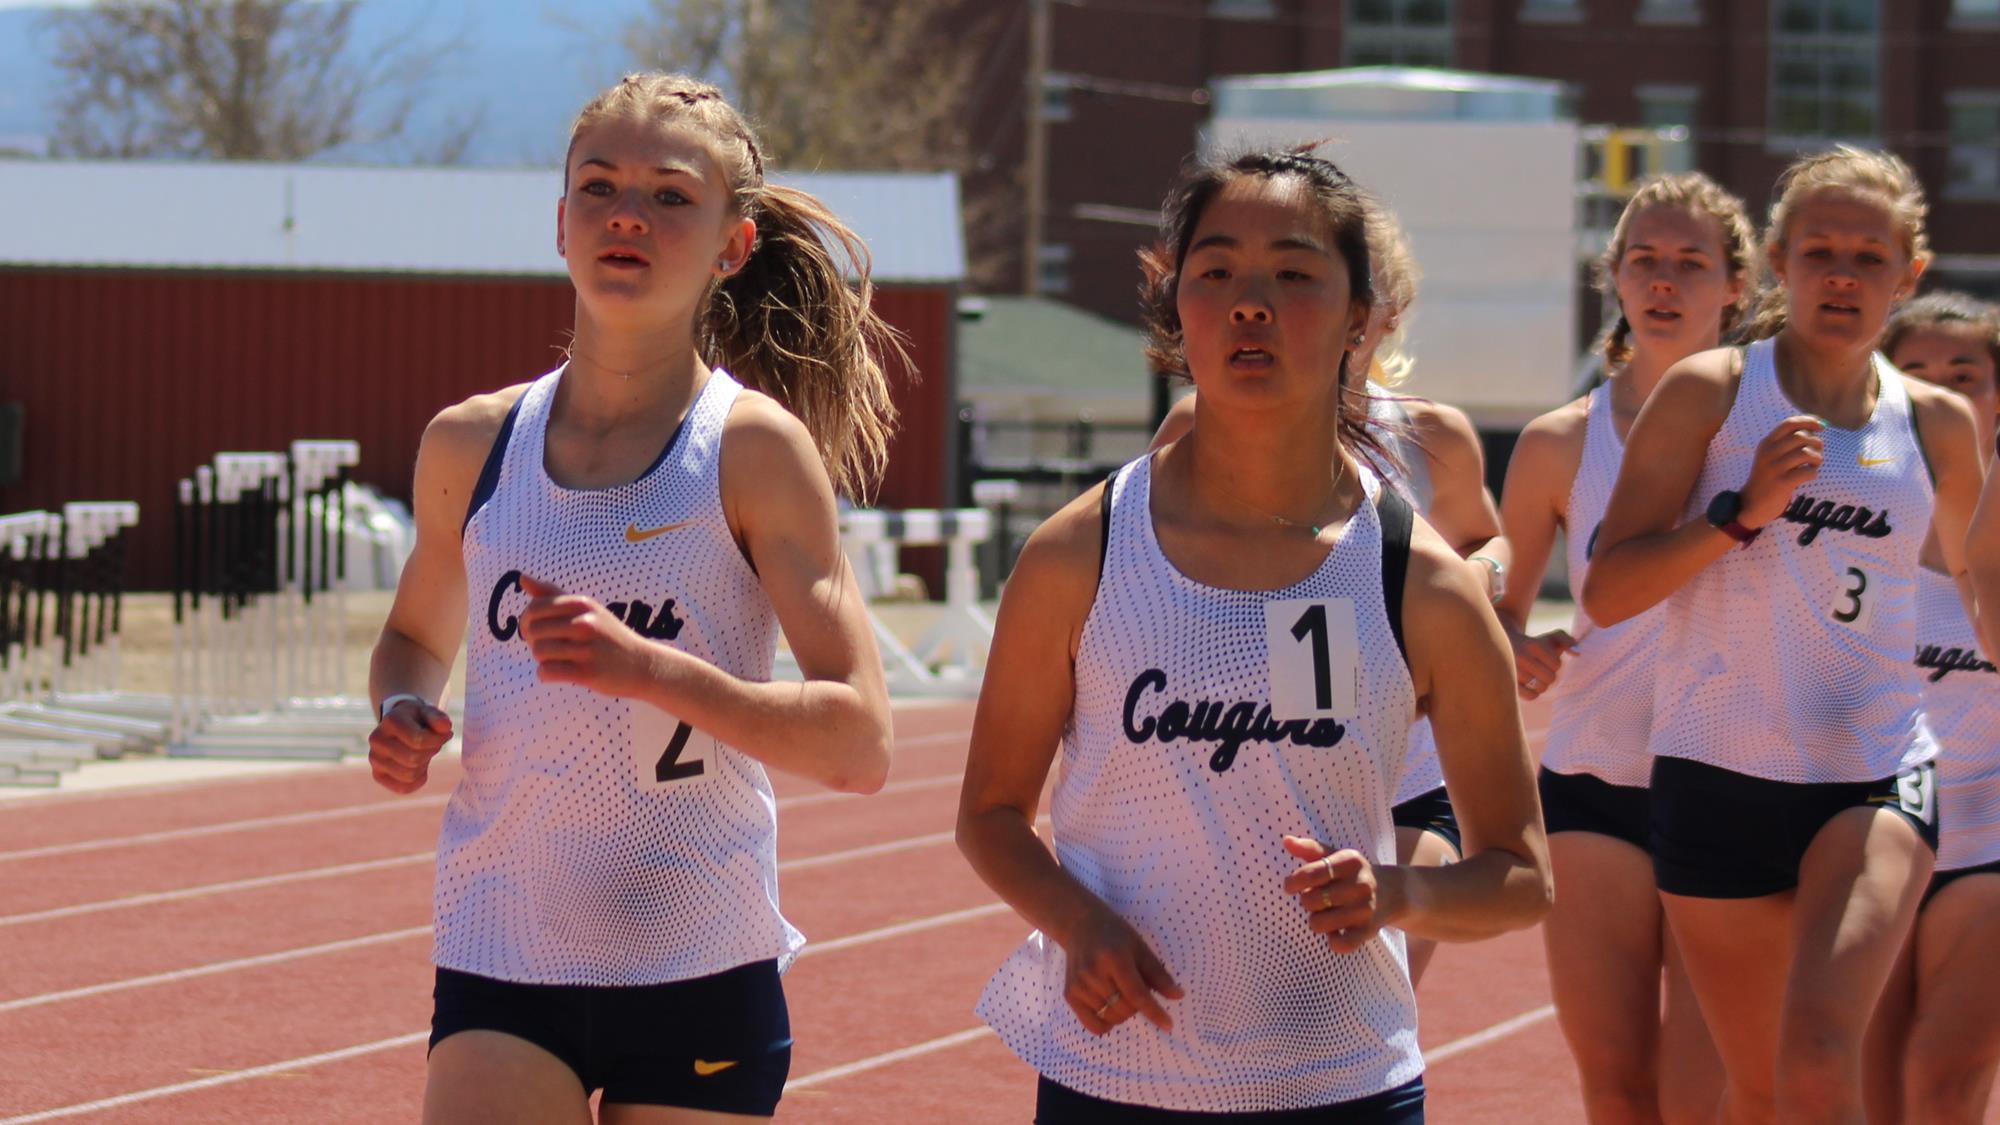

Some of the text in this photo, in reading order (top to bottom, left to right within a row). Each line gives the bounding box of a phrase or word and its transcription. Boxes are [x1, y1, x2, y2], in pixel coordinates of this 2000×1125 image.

[1831, 566, 1867, 623] 3
[1290, 604, 1333, 710] 1
[655, 721, 704, 782] 2
[1905, 768, 1924, 811] 3
